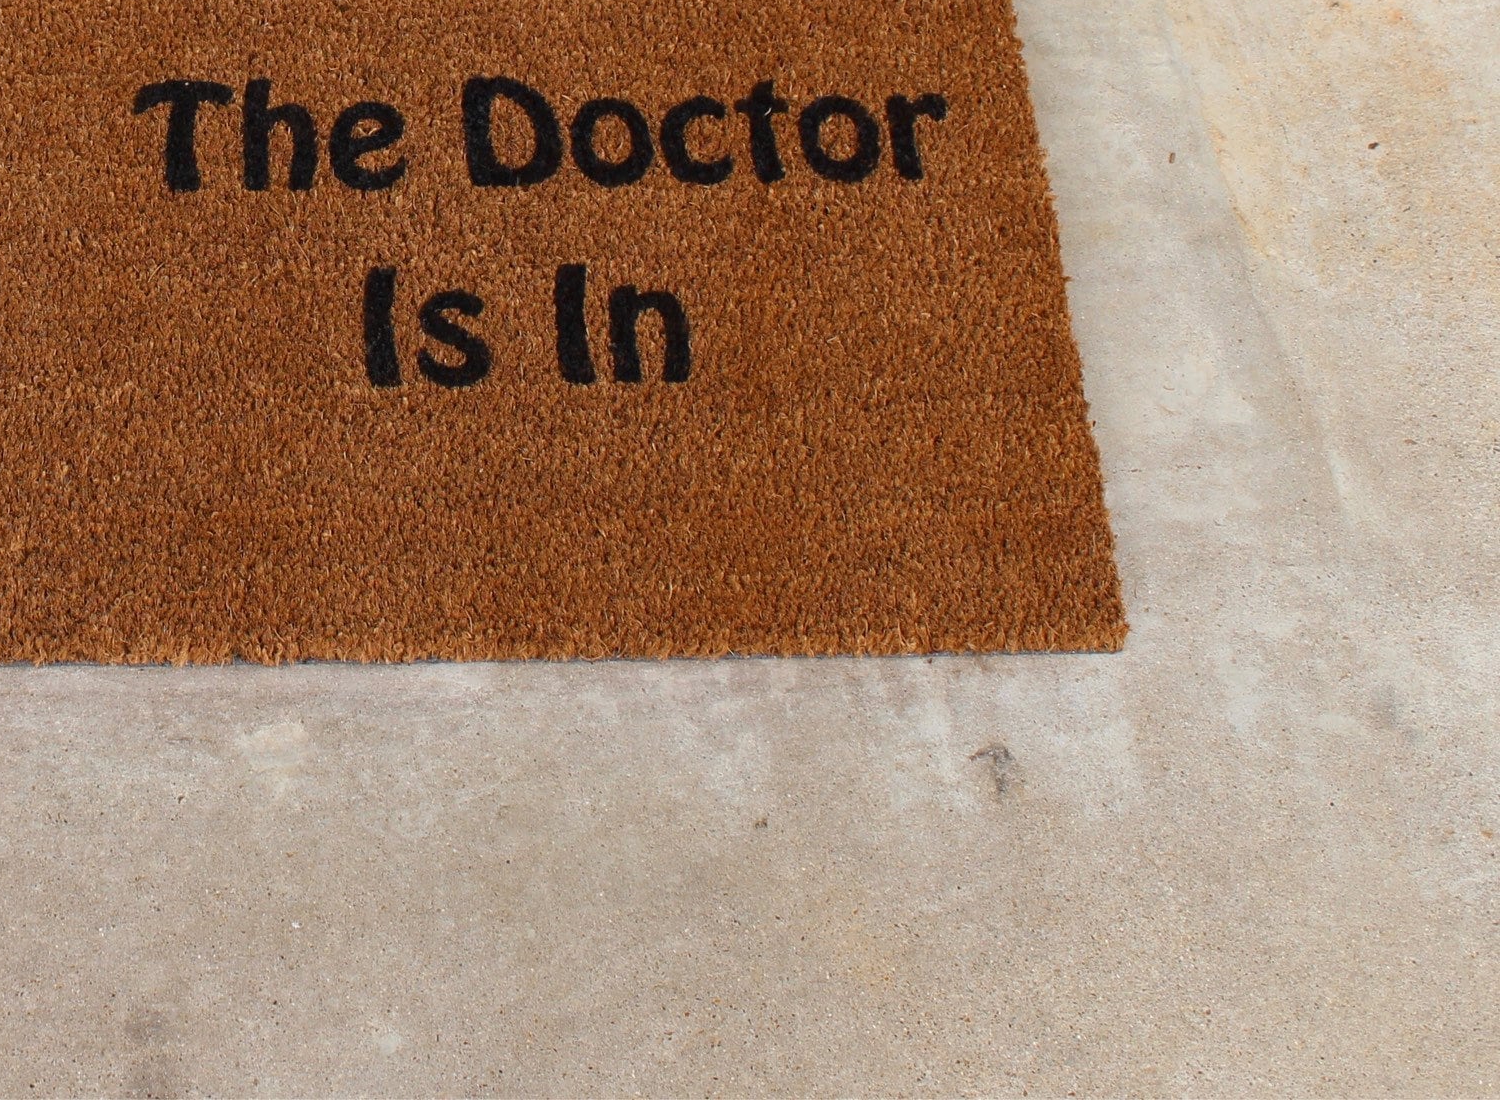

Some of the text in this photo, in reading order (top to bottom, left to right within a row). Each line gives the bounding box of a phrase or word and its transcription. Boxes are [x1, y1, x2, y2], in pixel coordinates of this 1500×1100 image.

[132, 74, 950, 195] The Doctor
[361, 261, 694, 389] Is In
